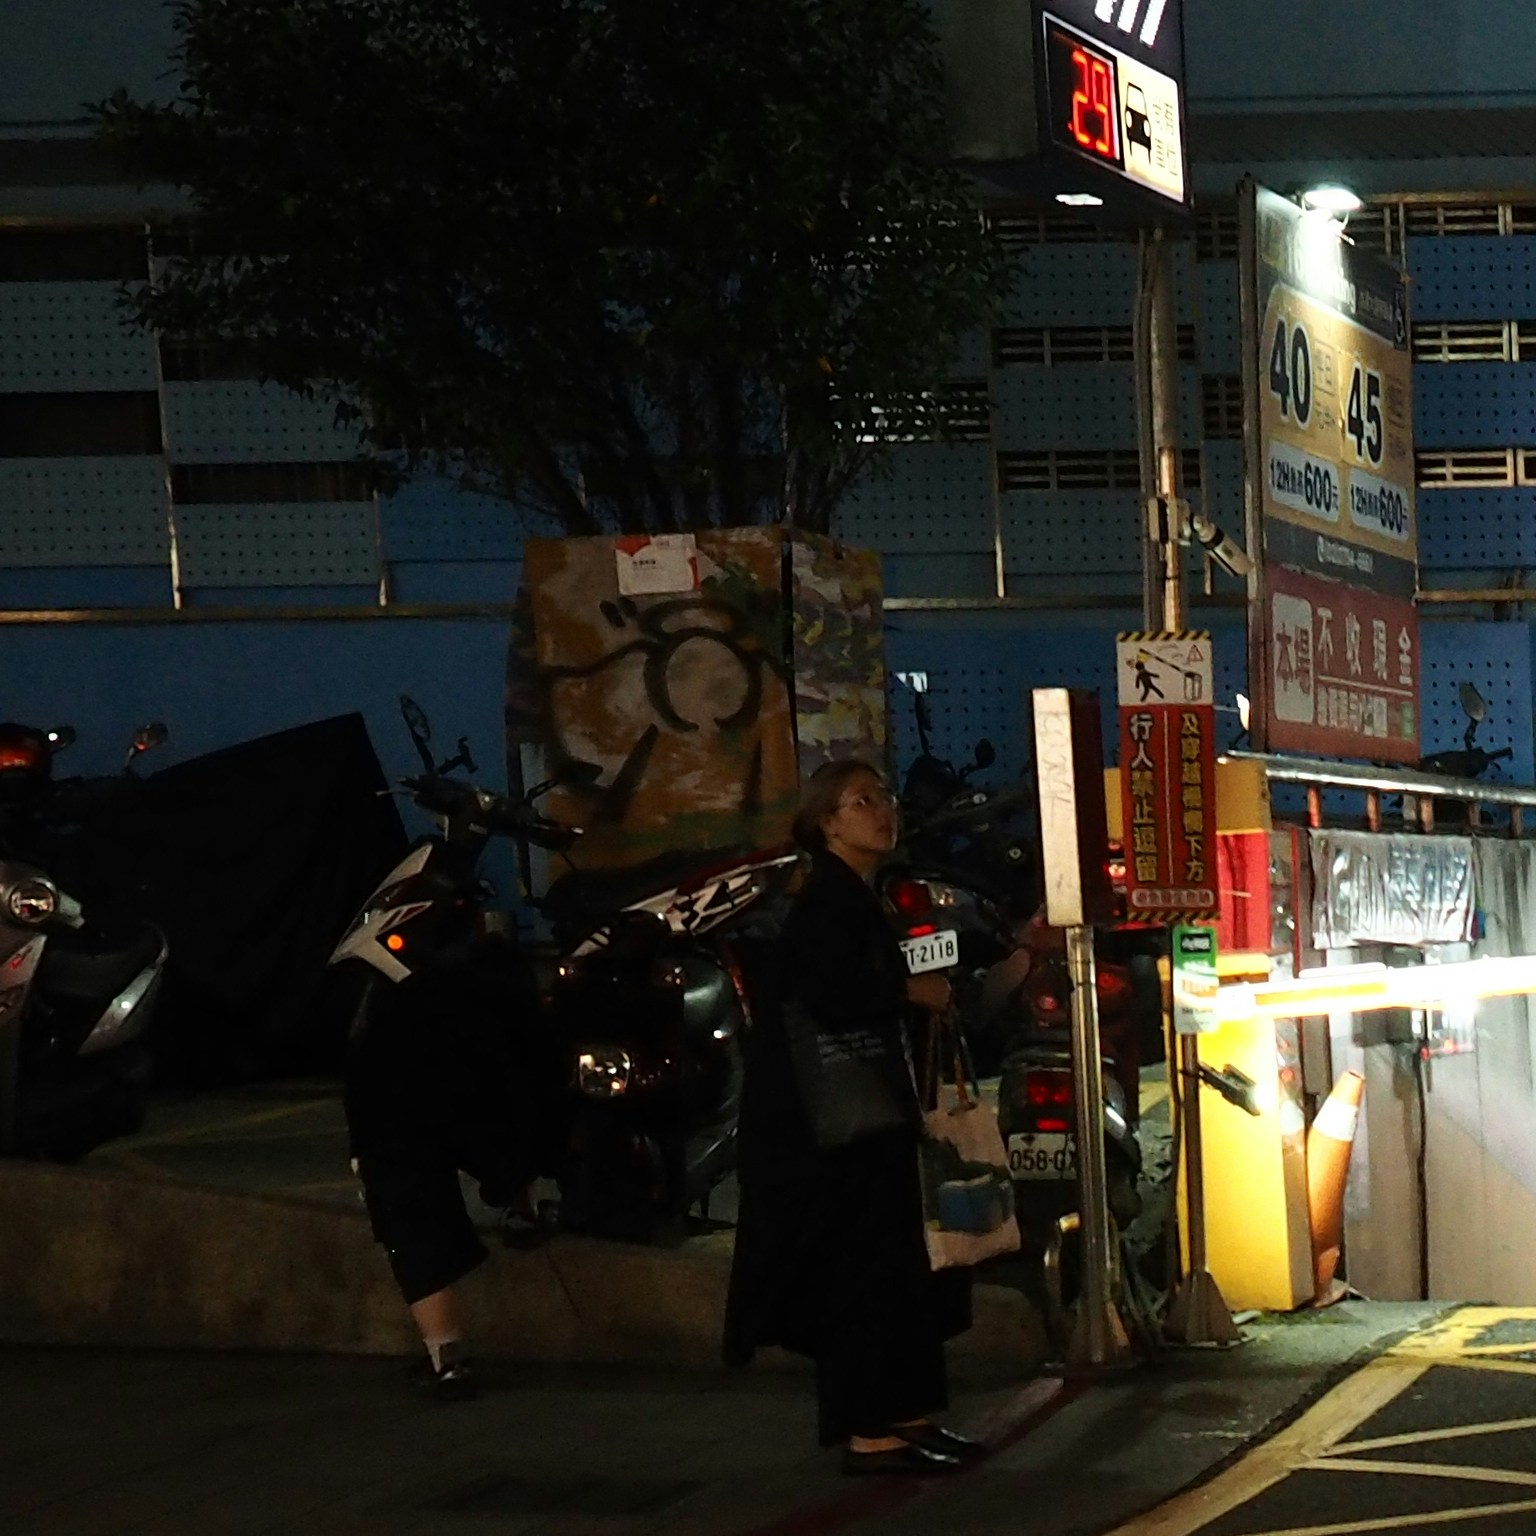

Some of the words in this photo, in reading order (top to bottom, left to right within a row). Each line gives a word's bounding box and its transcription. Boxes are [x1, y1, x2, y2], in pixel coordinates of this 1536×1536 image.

[1072, 48, 1111, 154] 29
[1270, 319, 1311, 424] 40
[1348, 368, 1382, 463] 45
